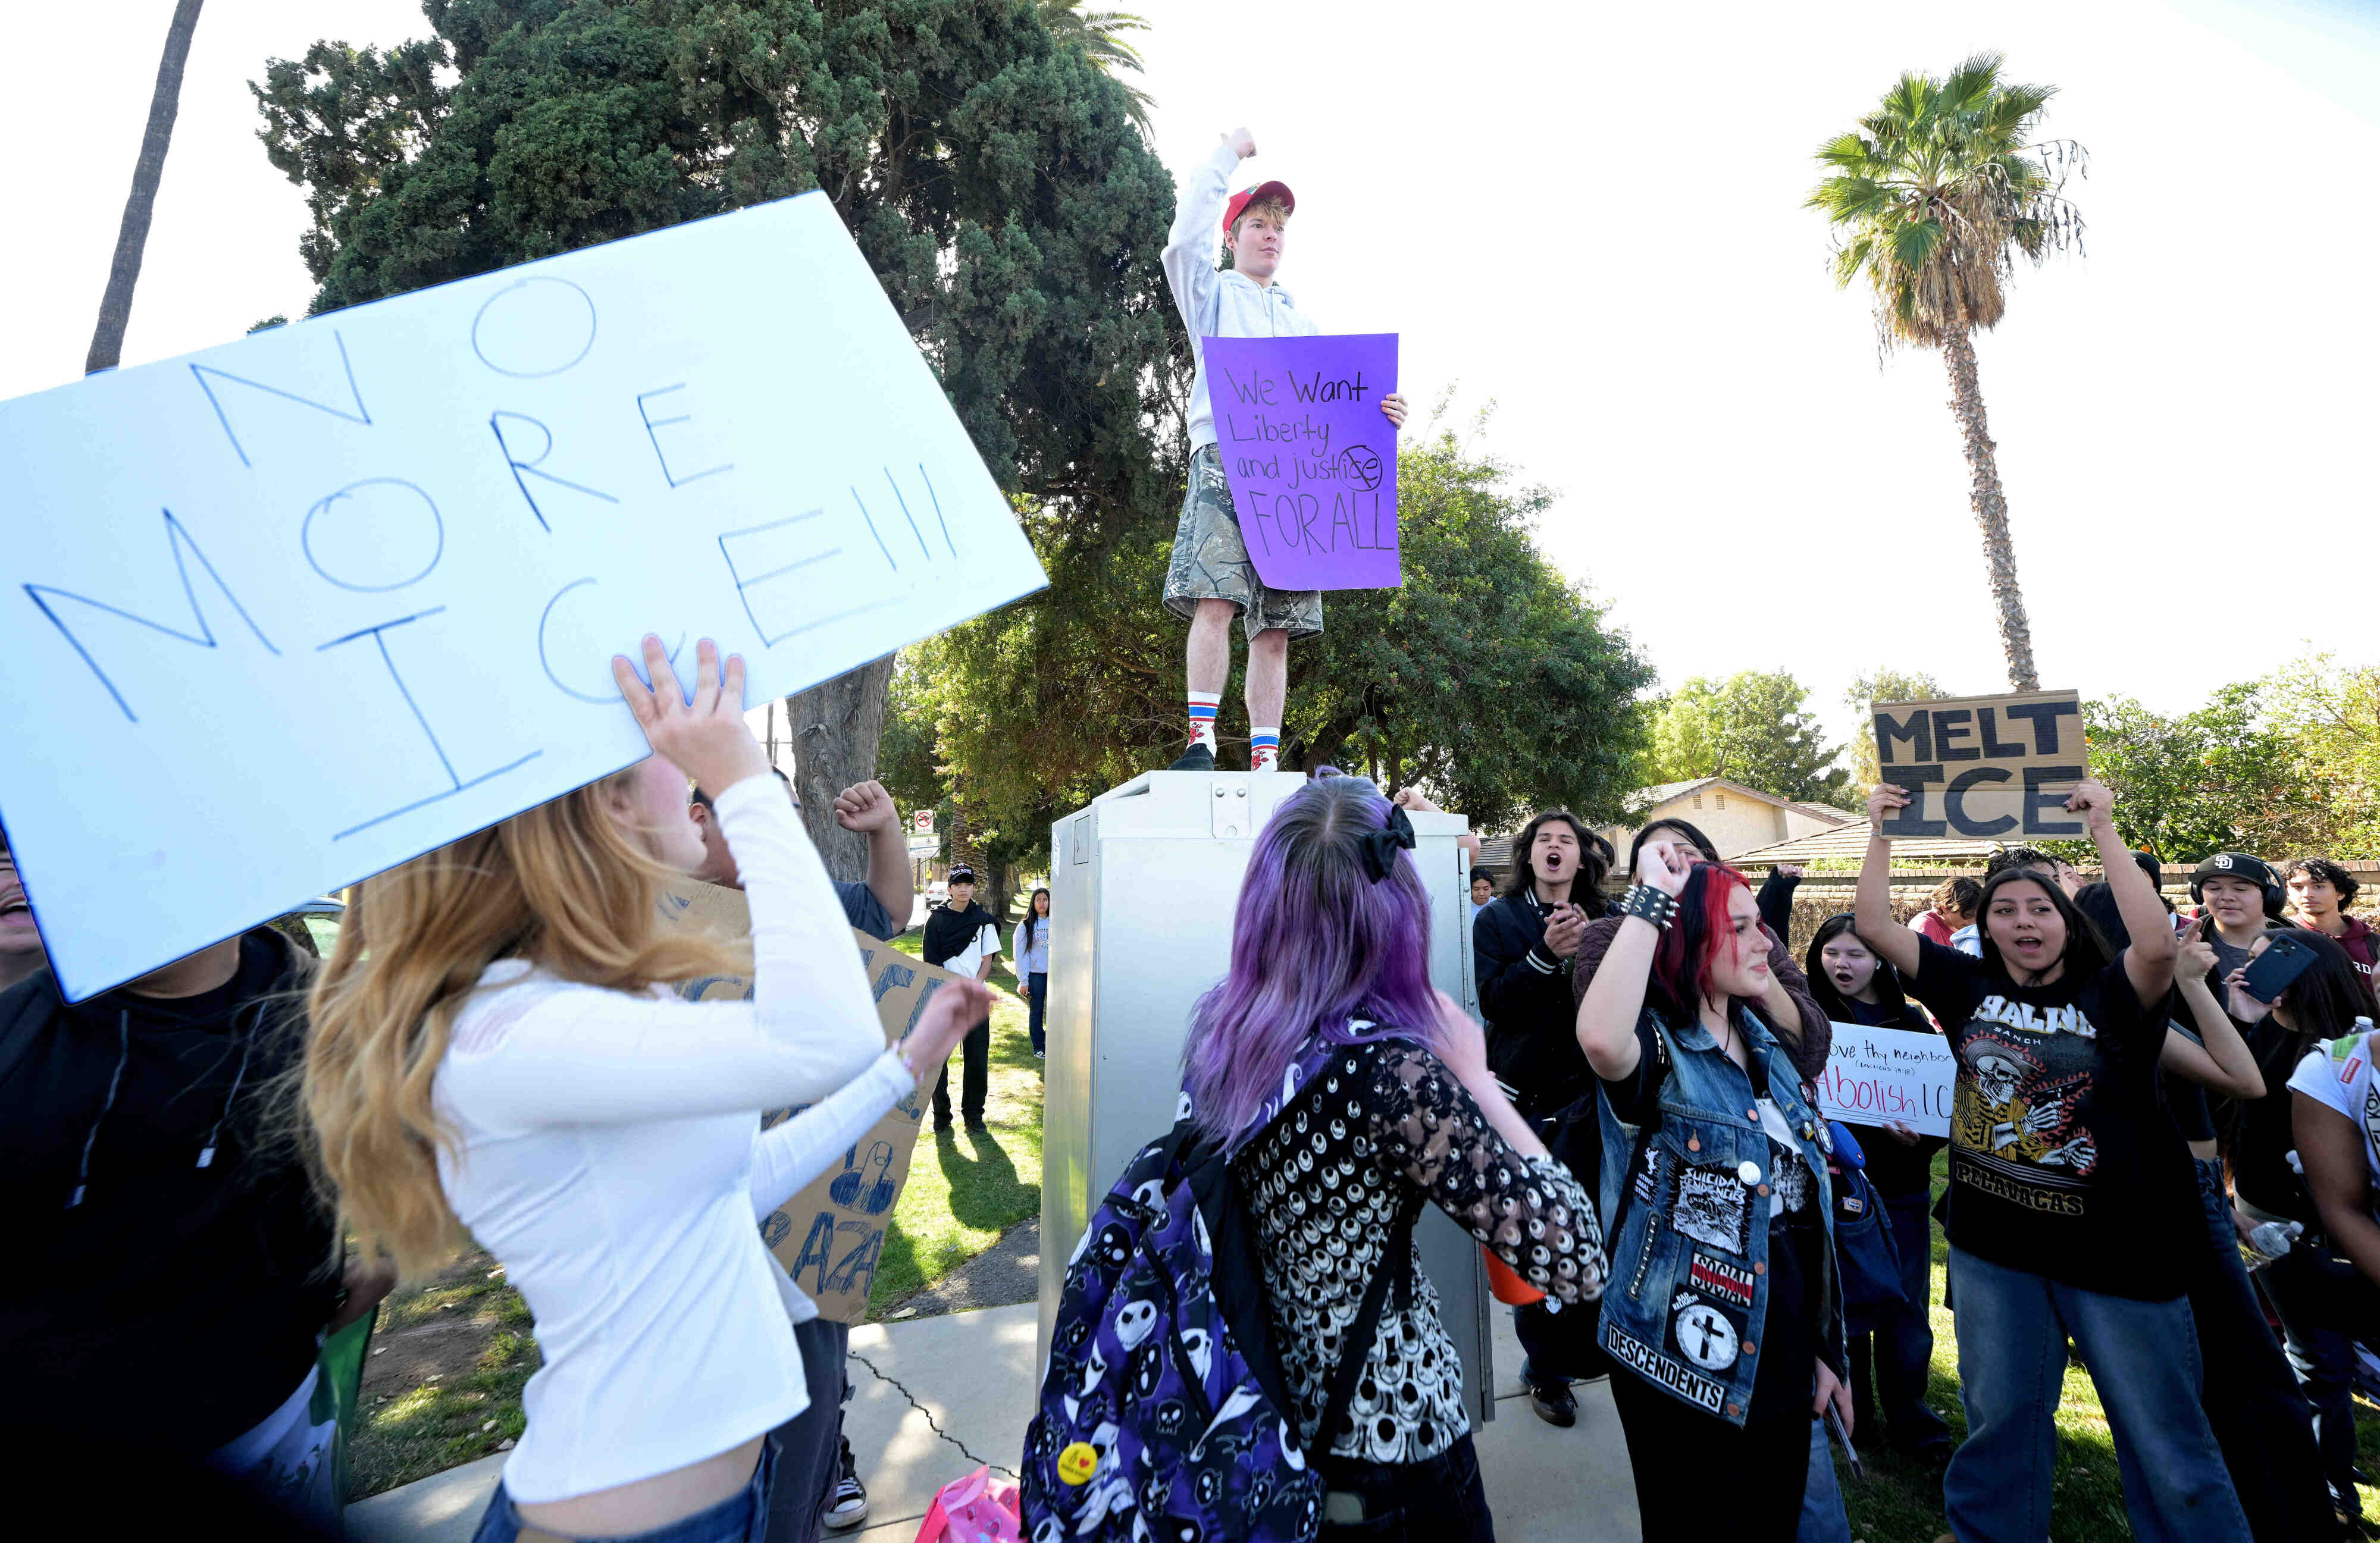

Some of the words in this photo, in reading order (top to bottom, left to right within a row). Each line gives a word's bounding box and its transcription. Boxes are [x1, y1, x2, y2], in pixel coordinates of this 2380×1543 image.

[189, 275, 597, 469] NO
[1223, 366, 1279, 406] We
[1288, 370, 1368, 403] Want
[1227, 413, 1330, 457] Liberty
[1237, 453, 1280, 479] and
[21, 382, 735, 724] MORE
[1249, 490, 1327, 557] FOR
[1332, 491, 1395, 553] ALL
[1874, 700, 2078, 763] MELT
[1880, 764, 2083, 838] ICE
[1829, 1042, 1856, 1058] ove
[1864, 1039, 1887, 1065] thy
[1894, 1049, 1953, 1064] neighbor
[1815, 1065, 1916, 1118] Abolish
[1609, 1327, 1722, 1408] DESCENDENTS
